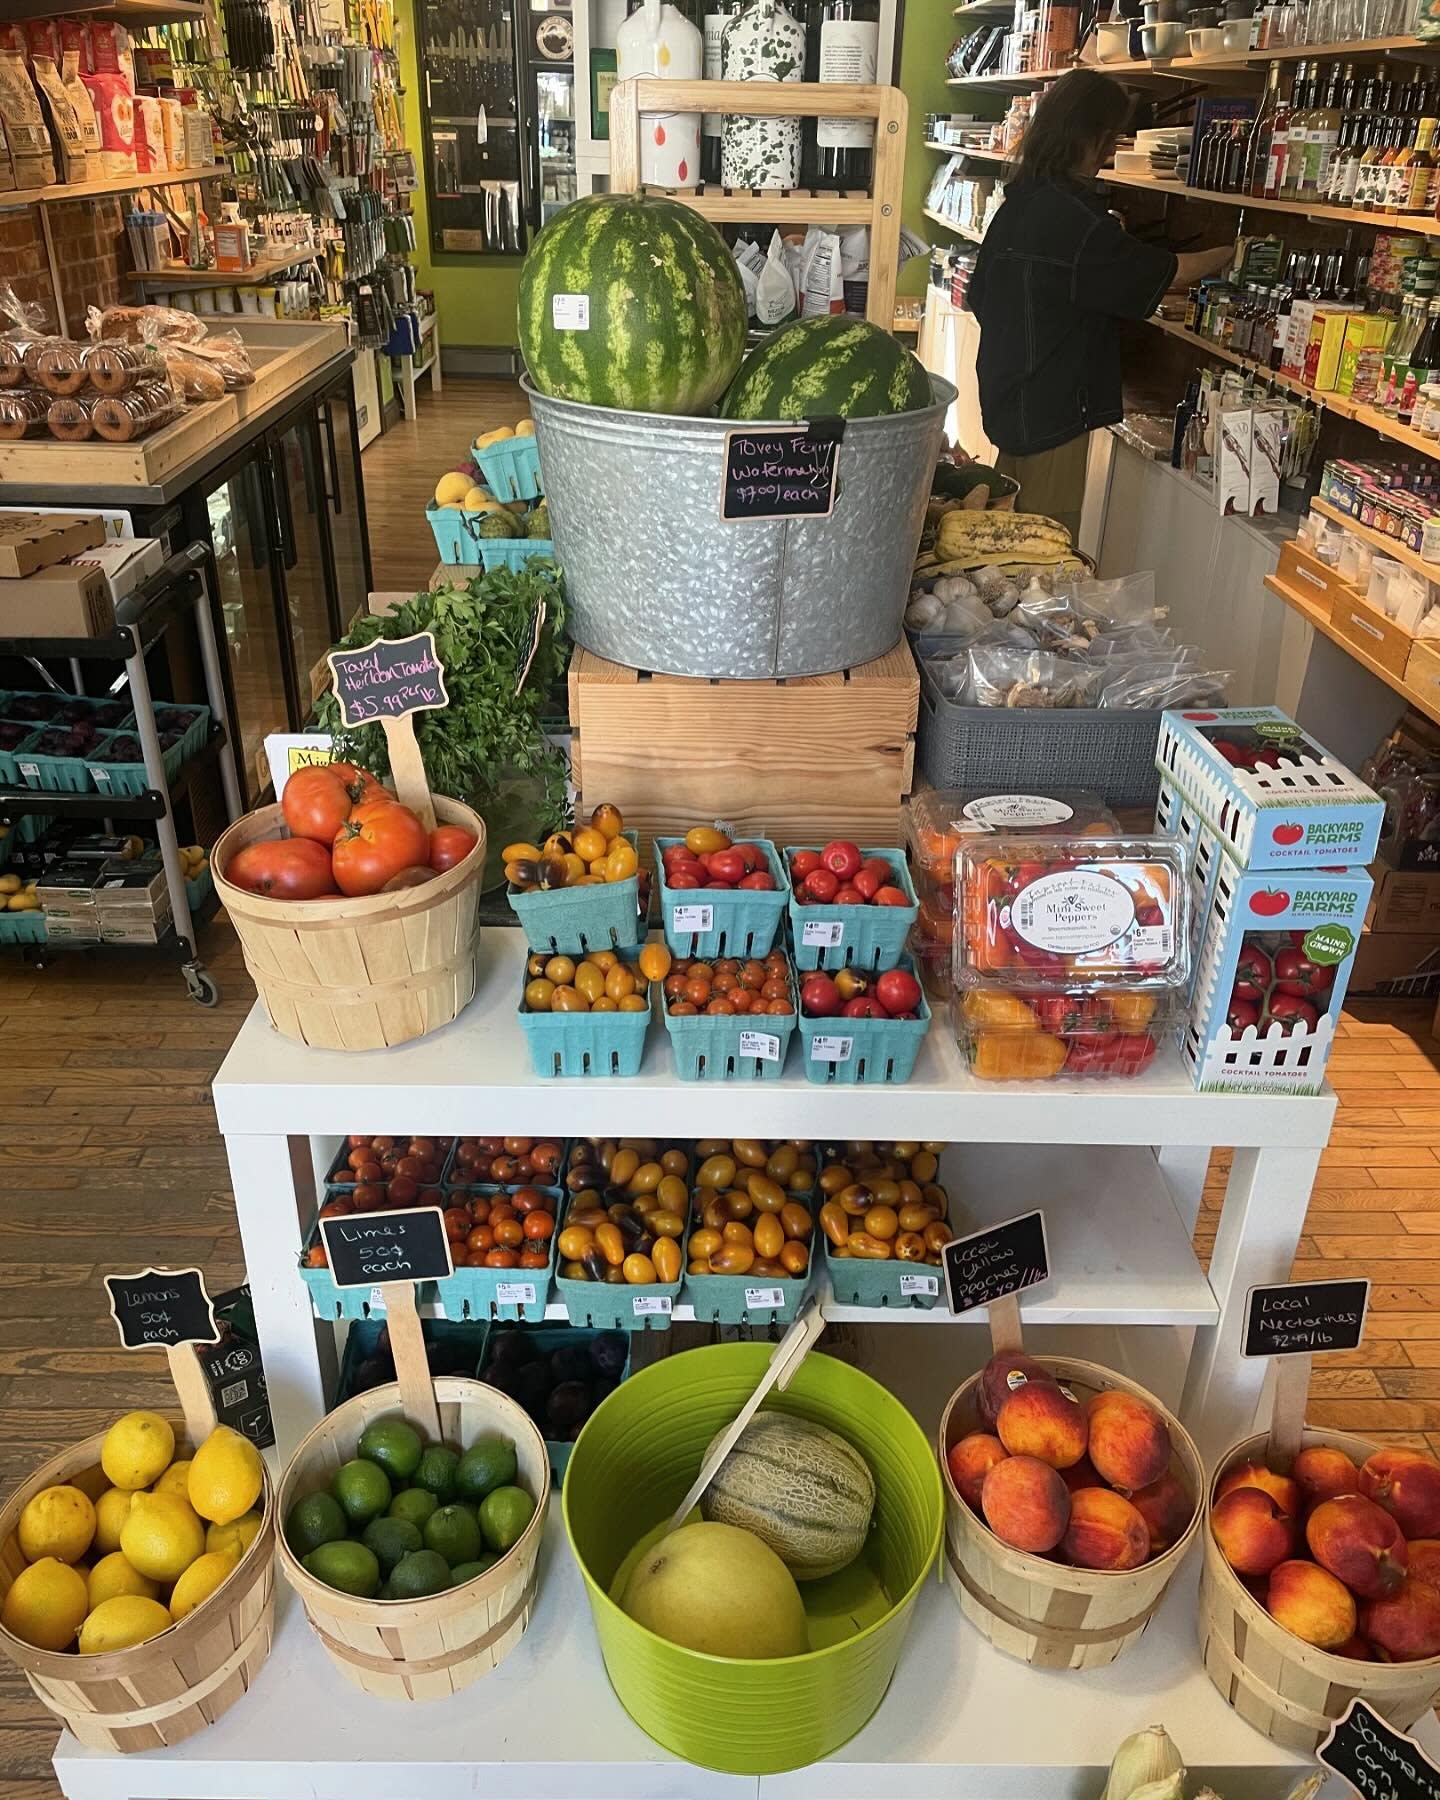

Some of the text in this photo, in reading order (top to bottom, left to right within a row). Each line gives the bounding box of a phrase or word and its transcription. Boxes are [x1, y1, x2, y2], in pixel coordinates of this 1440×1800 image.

[1307, 822, 1364, 834] BACKYARD
[1306, 833, 1363, 846] FARMS
[1269, 847, 1359, 858] COCKTAIL TOMATOES
[1295, 890, 1358, 903] BACKYARD
[1046, 902, 1107, 914] Mini Sweet
[1292, 901, 1356, 914] FARMS
[1055, 914, 1098, 924] Peppers
[1309, 940, 1345, 957] GROWN
[1314, 933, 1348, 951] MAINE
[1221, 1068, 1261, 1077] COCKTAIL
[340, 1224, 406, 1242] Limes
[361, 1260, 412, 1274] each
[124, 1287, 182, 1308] Lemons
[1262, 1296, 1311, 1313] Local
[140, 1310, 172, 1325] 50¢
[143, 1327, 179, 1342] each
